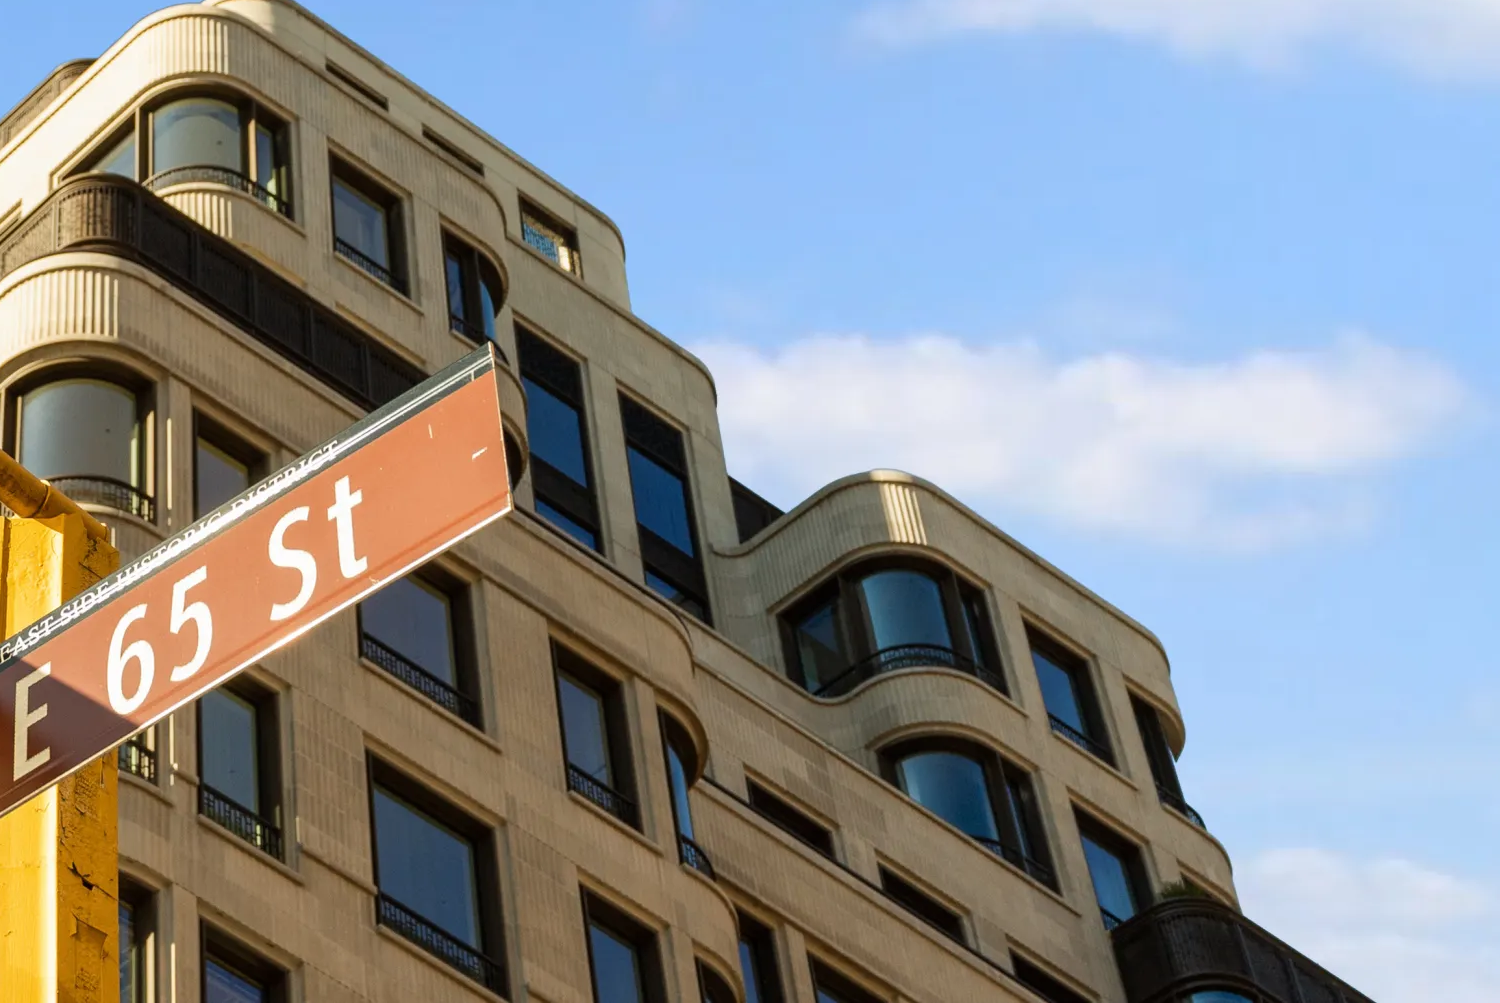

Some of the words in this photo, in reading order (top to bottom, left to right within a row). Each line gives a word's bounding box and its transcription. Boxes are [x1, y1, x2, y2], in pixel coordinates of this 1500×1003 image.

[13, 661, 51, 782] E
[107, 566, 213, 716] 65
[268, 475, 368, 620] St
[60, 581, 110, 625] SIDE
[115, 512, 224, 589] HISTORIC
[230, 439, 338, 517] DISTRICT
